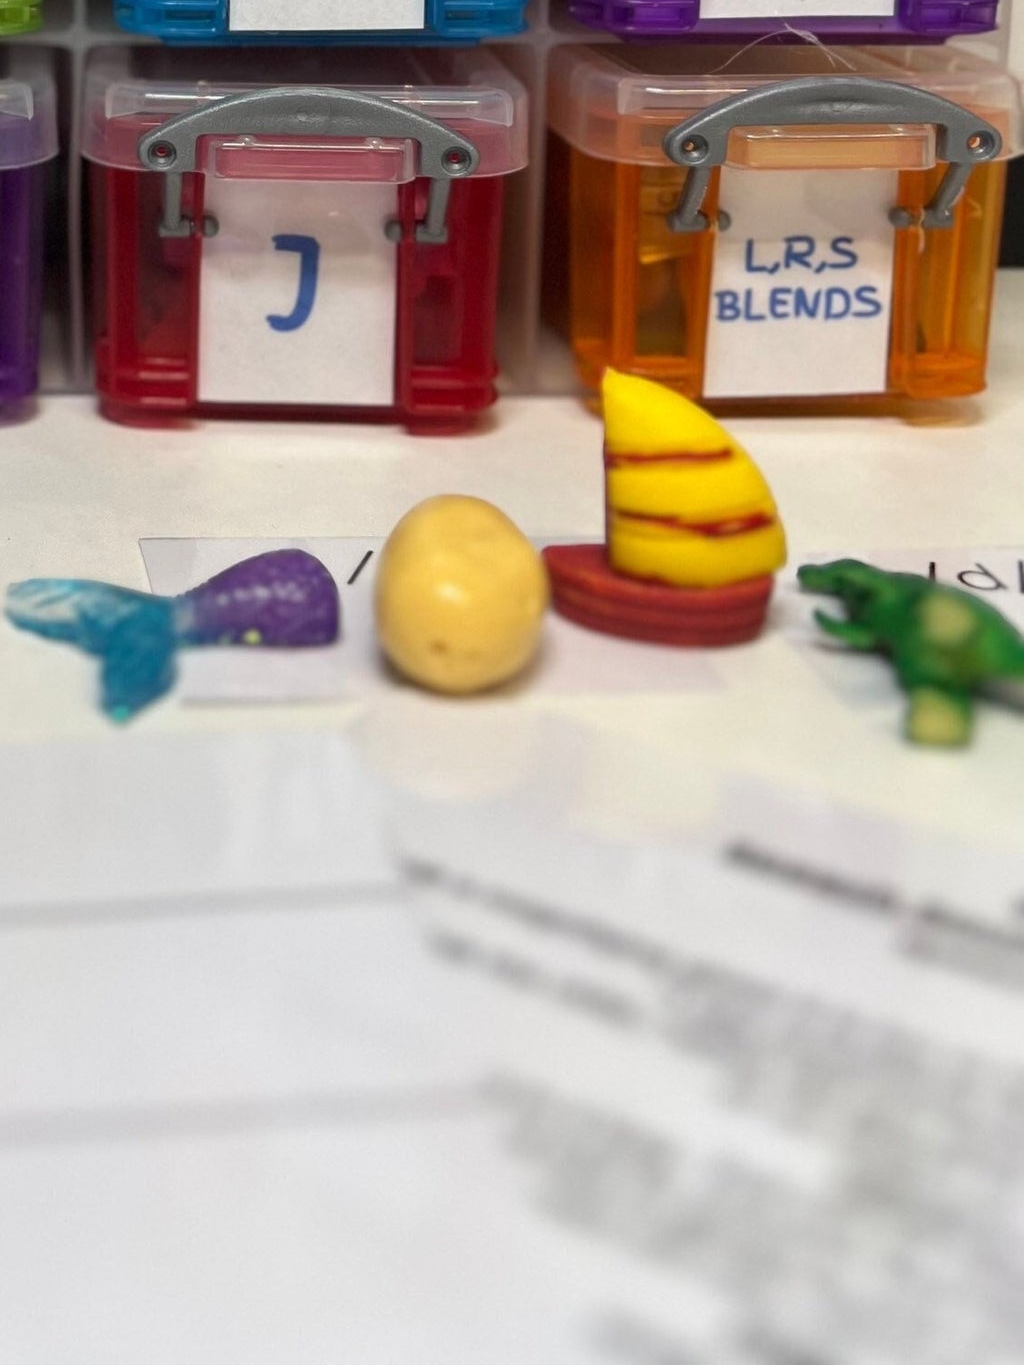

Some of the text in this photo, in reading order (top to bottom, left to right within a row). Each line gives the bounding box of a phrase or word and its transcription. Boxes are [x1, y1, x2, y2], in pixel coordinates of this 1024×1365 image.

[744, 235, 858, 275] L,R,S
[265, 234, 322, 333] J
[715, 285, 882, 322] BLENDS
